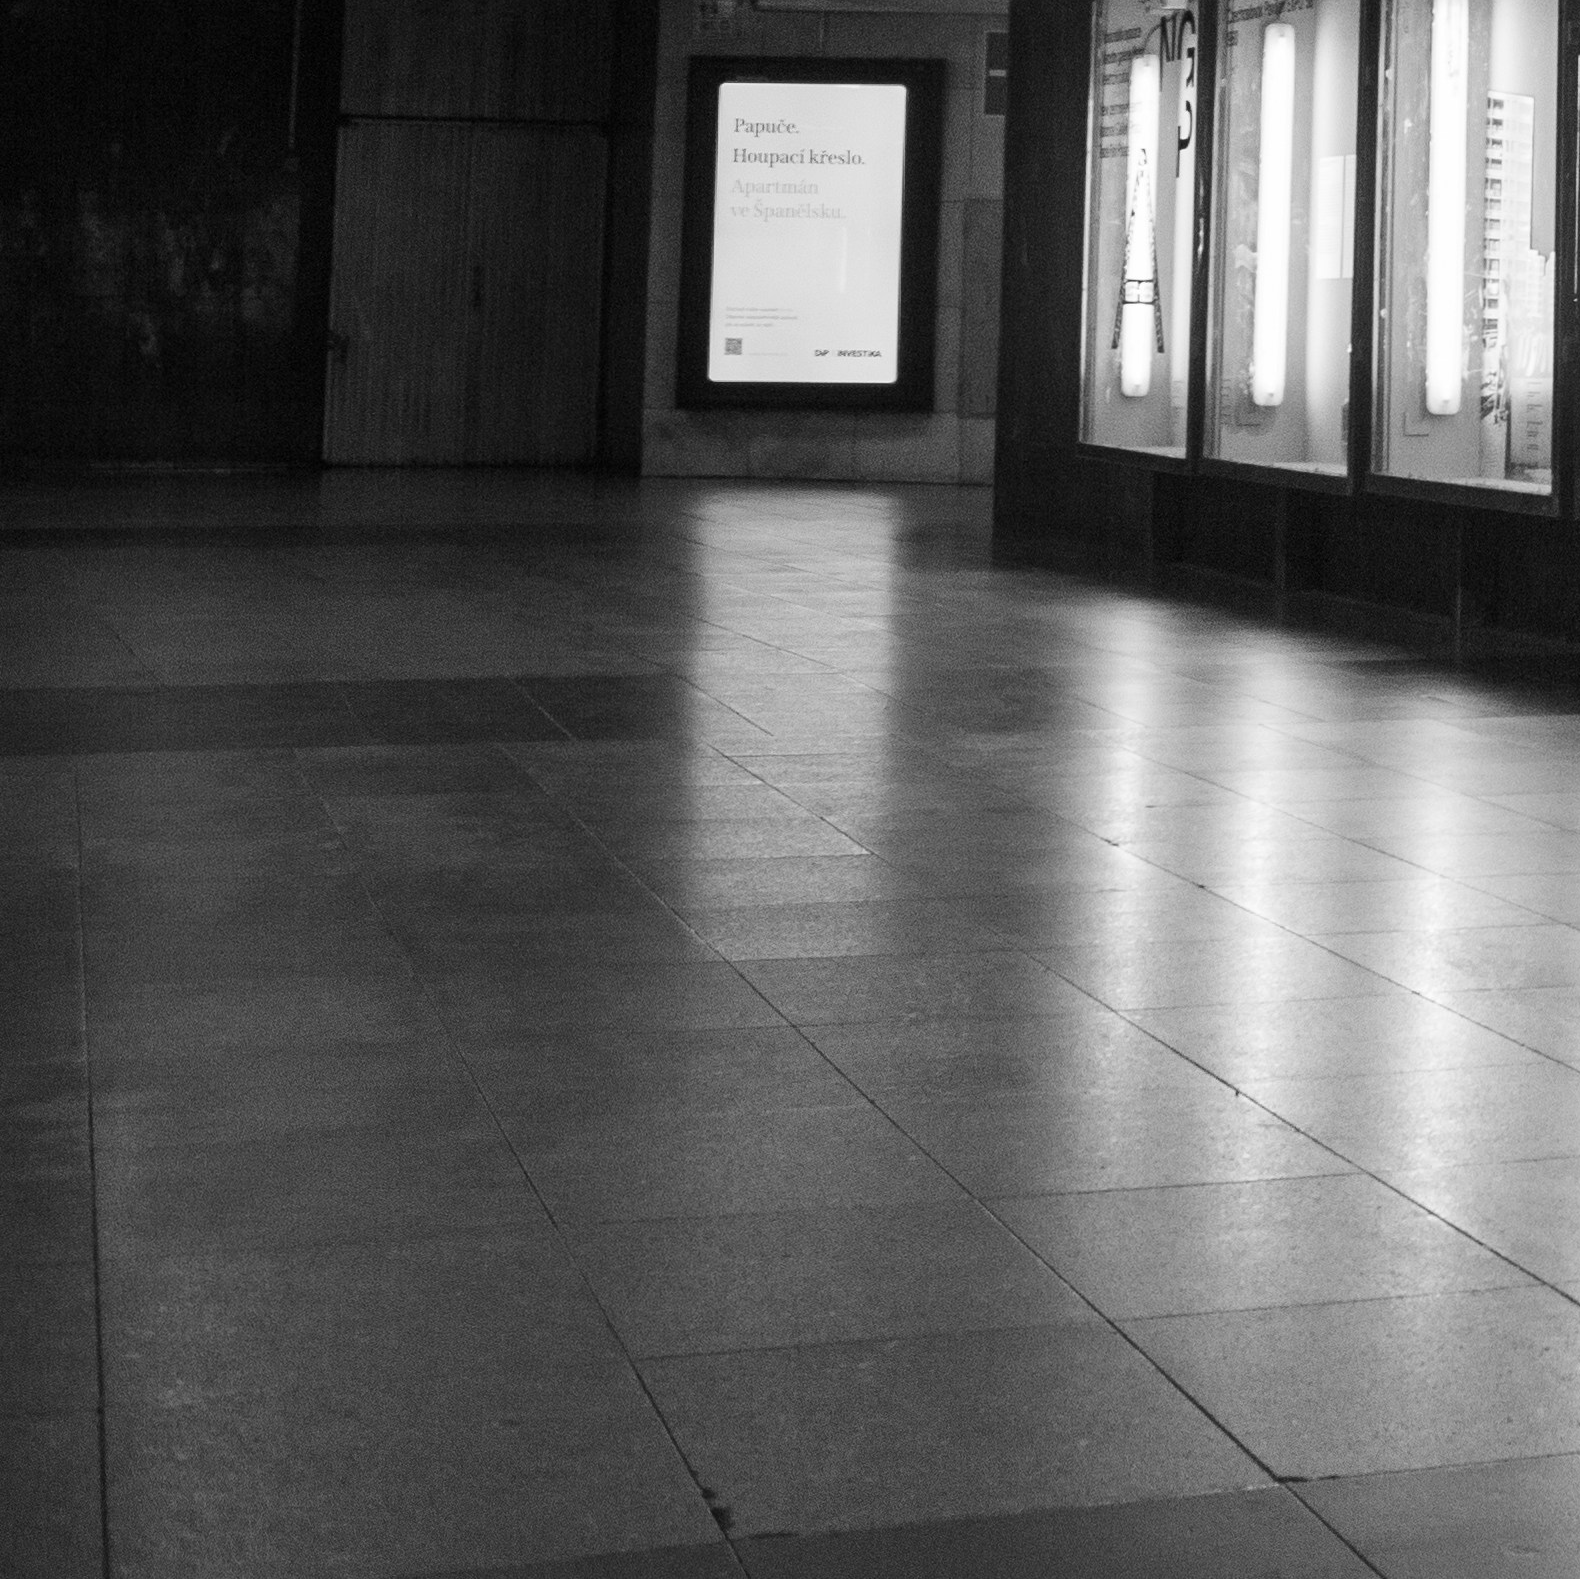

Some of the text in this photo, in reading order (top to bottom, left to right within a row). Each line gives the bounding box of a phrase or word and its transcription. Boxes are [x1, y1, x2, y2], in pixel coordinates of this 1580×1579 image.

[734, 118, 800, 138] Papuče.
[733, 148, 867, 168] Houpací křeslo.
[731, 179, 820, 198] Apartmán
[730, 199, 847, 222] ve Španělsku.
